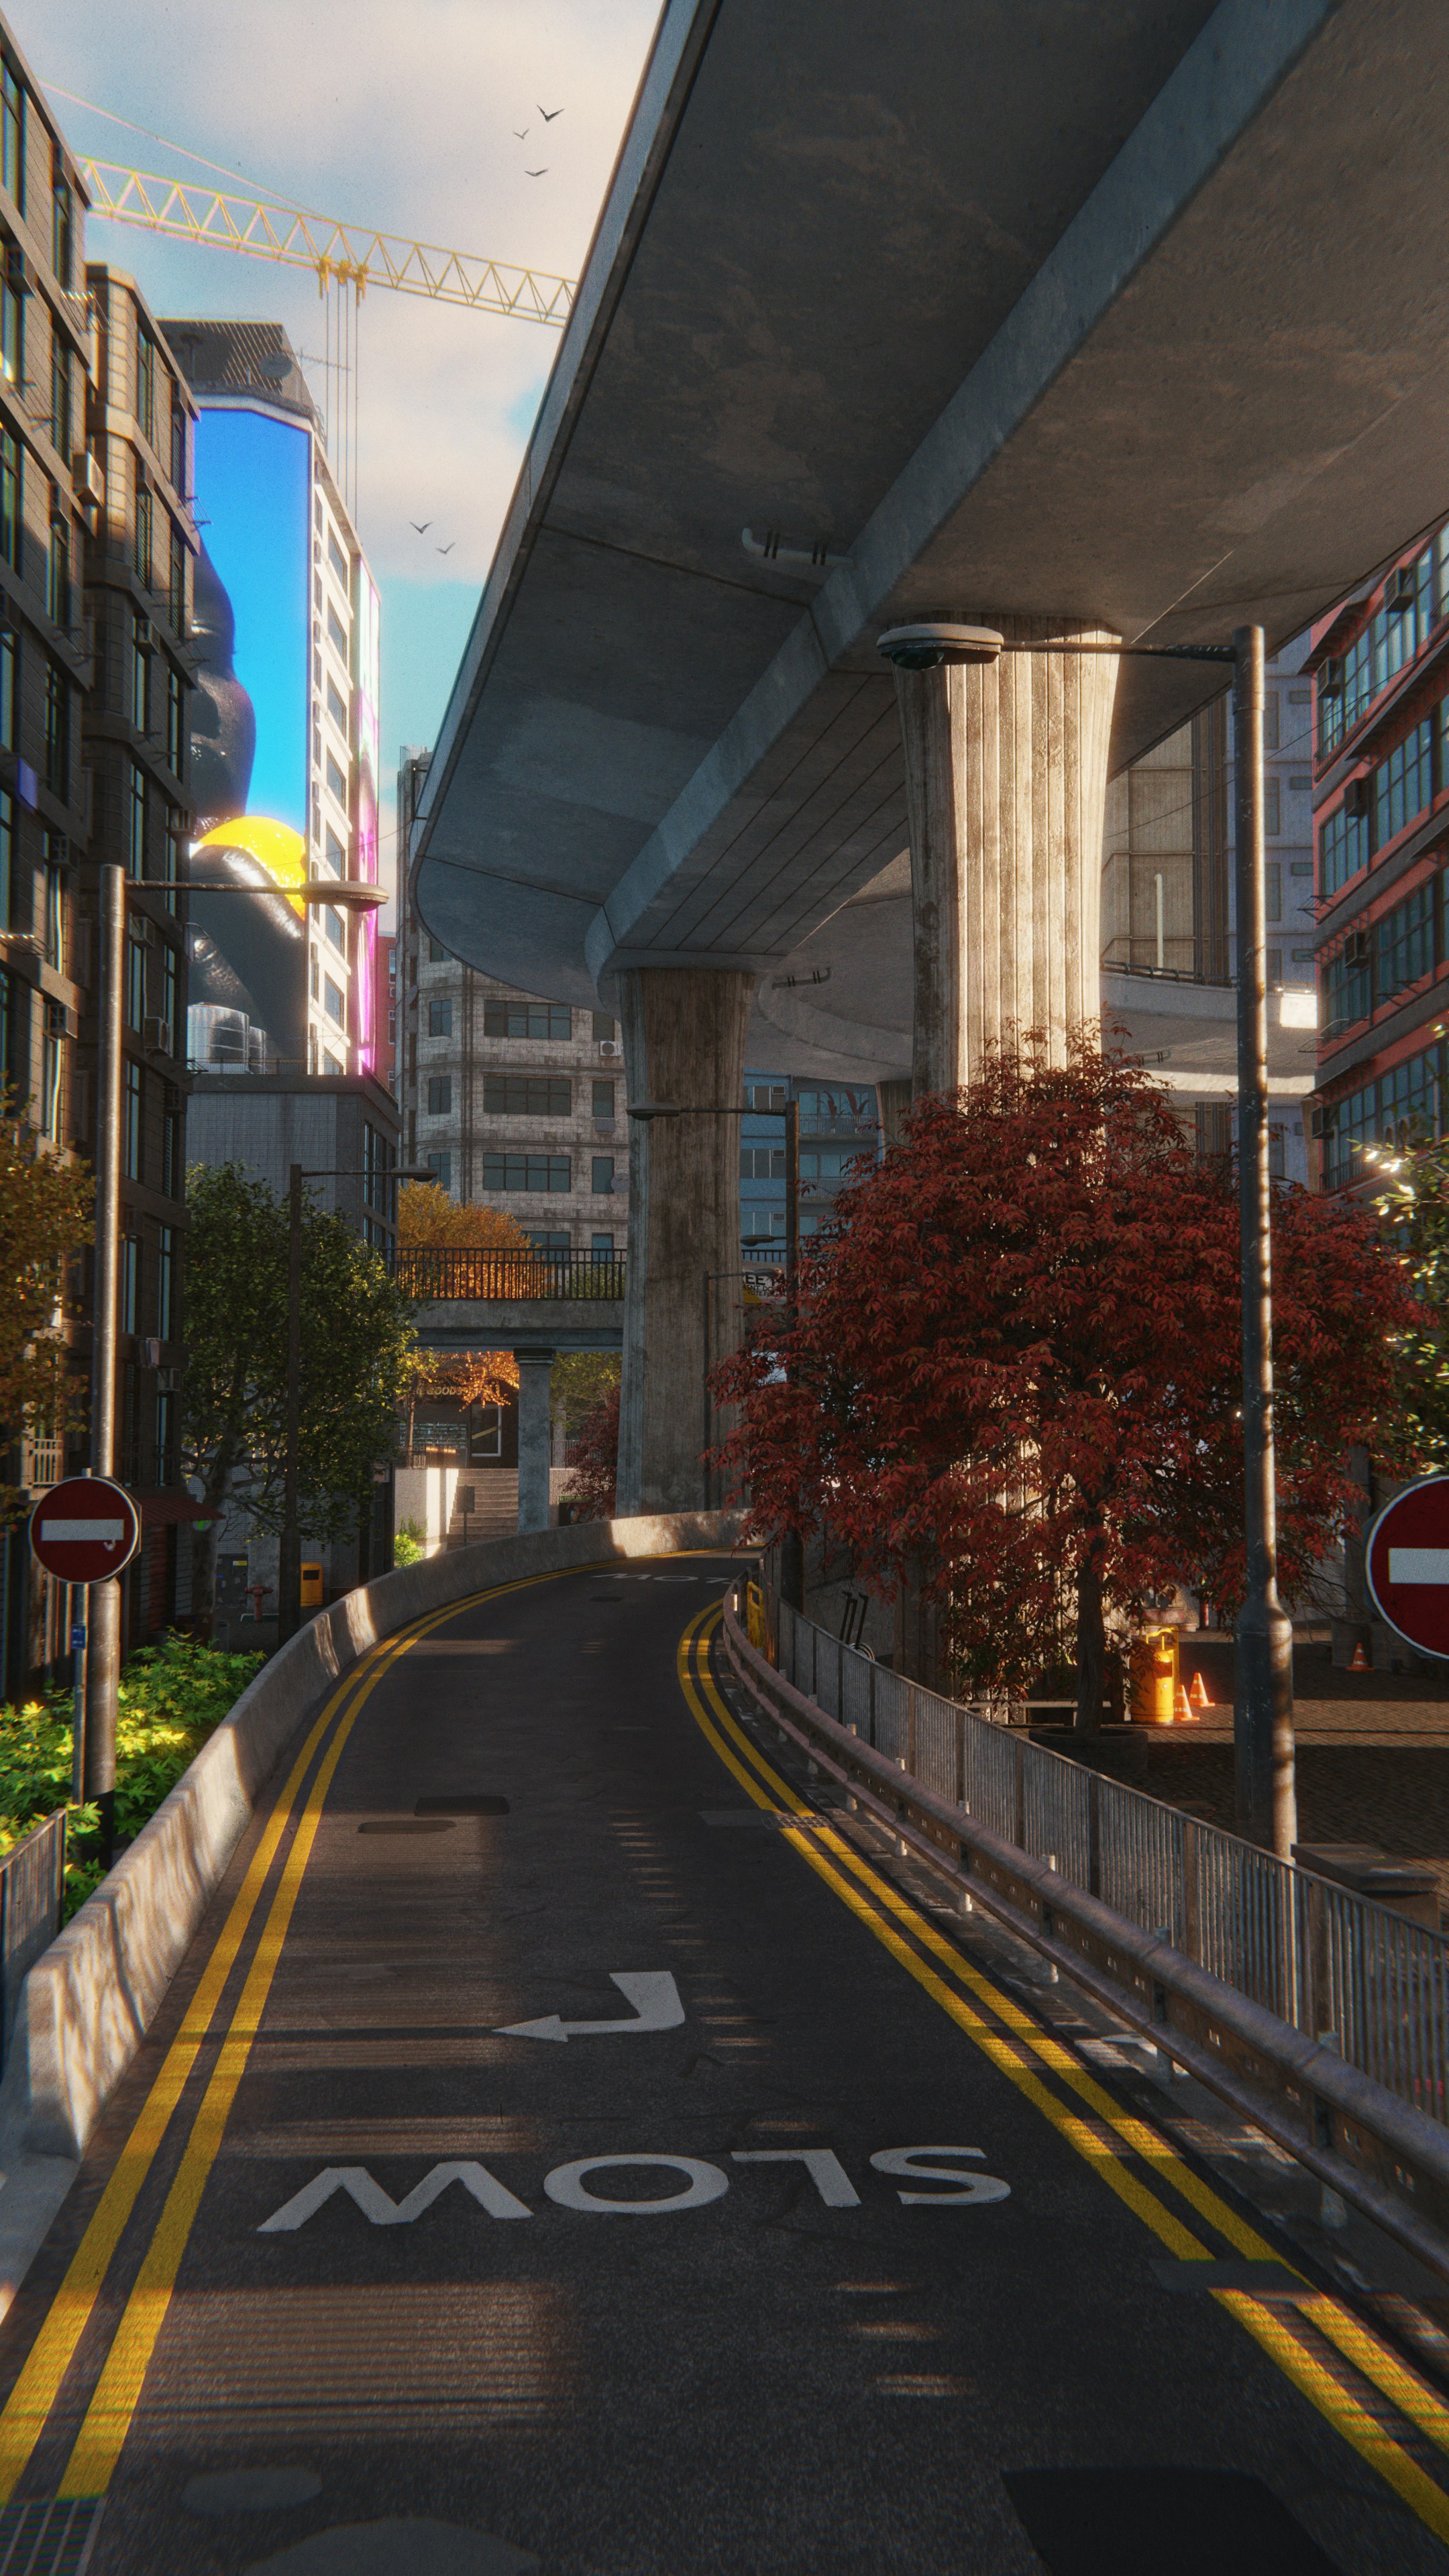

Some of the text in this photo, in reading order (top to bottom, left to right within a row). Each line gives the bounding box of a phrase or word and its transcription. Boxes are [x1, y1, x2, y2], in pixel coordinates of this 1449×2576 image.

[743, 1272, 765, 1285] EE
[591, 1573, 733, 1585] LOW
[256, 2145, 1012, 2233] SLOW
